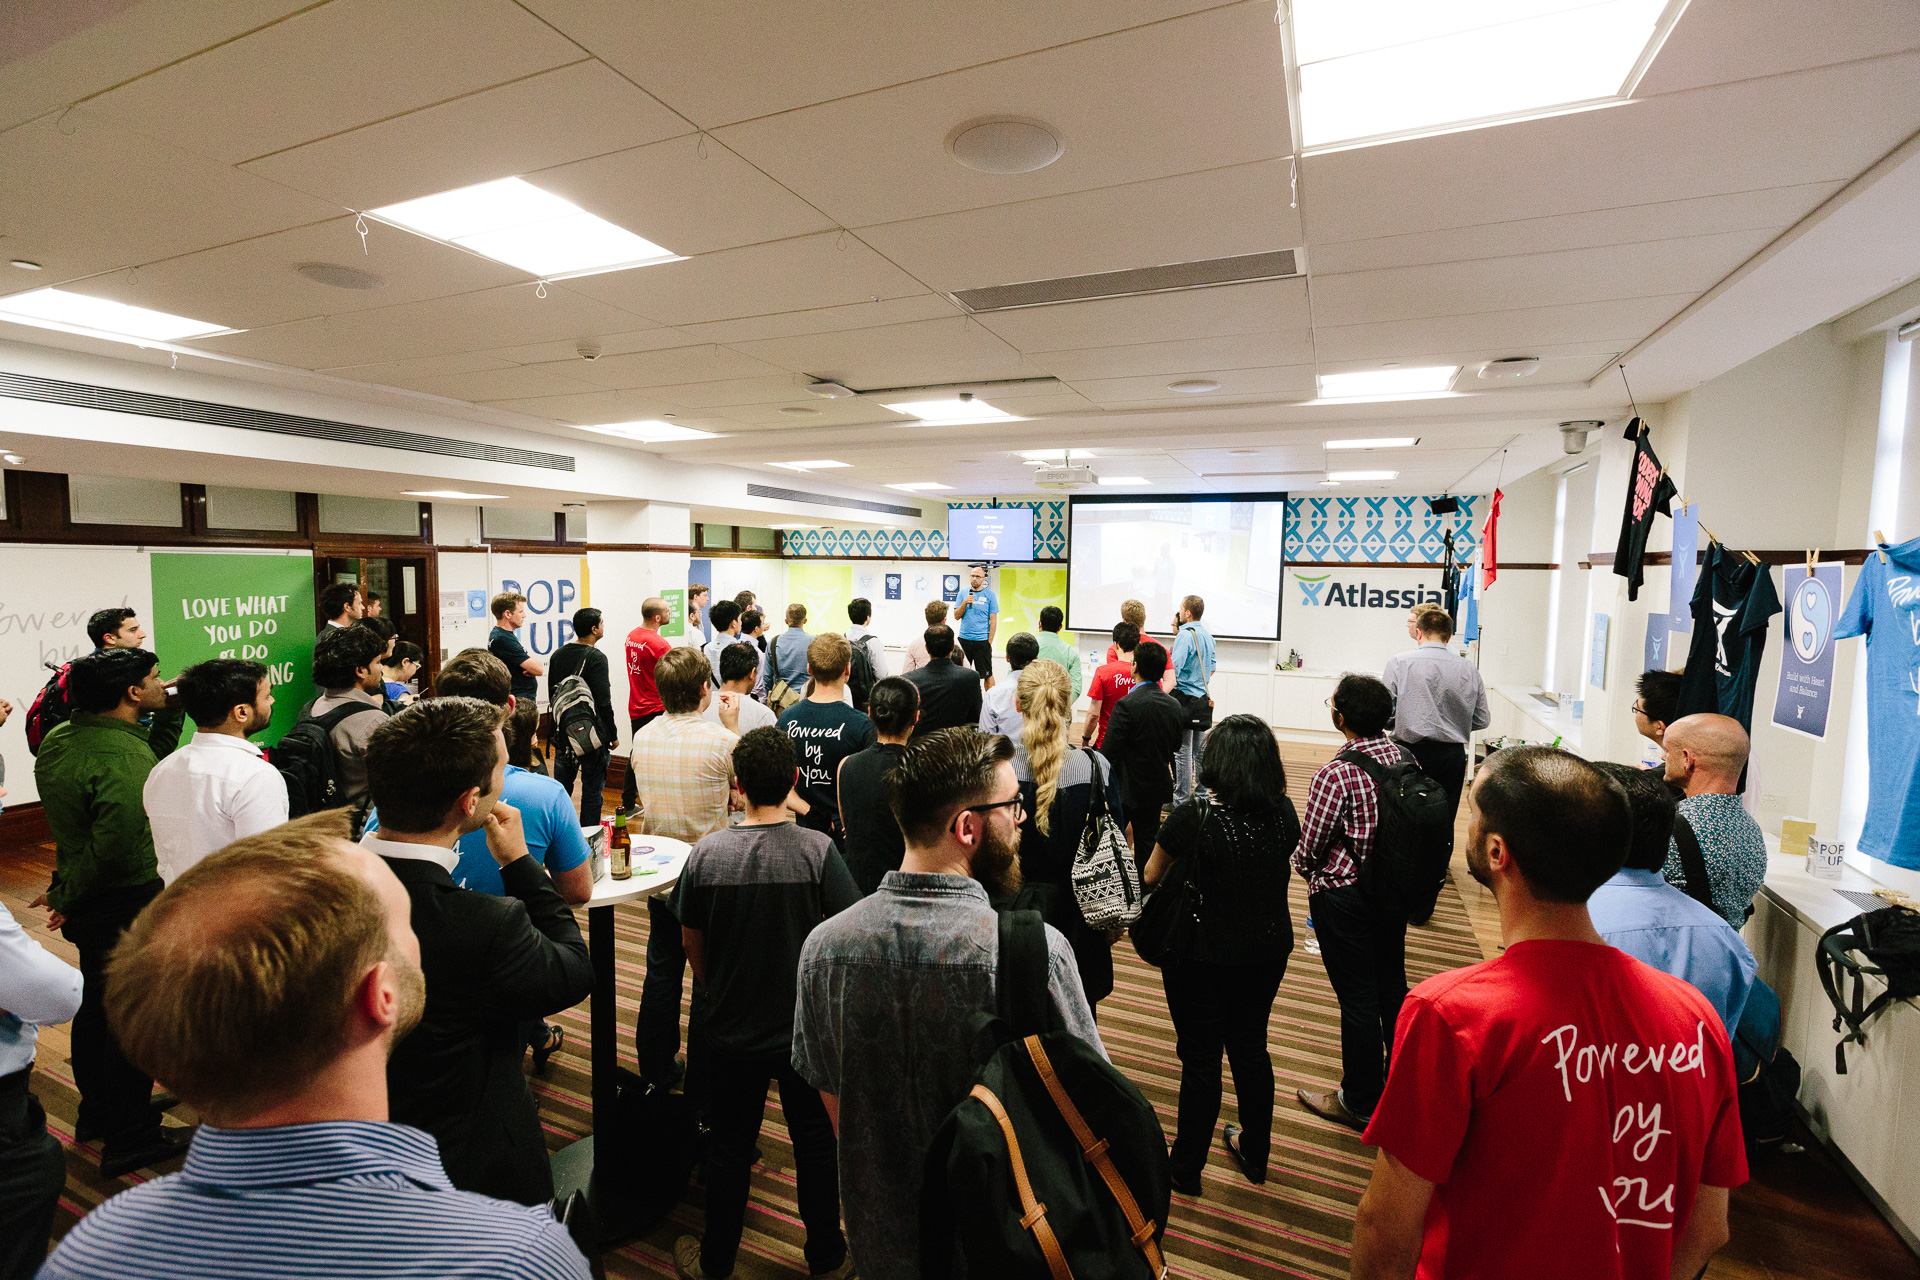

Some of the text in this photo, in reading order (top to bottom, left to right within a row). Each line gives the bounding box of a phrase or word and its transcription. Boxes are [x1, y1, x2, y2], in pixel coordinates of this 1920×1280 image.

[182, 595, 289, 620] LOVE WHAT
[204, 619, 278, 646] YOU DO
[530, 619, 575, 655] UP
[242, 644, 268, 659] DO
[1113, 673, 1136, 689] Powe
[1786, 671, 1825, 687] Build with Heart
[1789, 685, 1818, 698] and Balance
[787, 720, 846, 741] Powered
[805, 740, 824, 765] by
[1820, 843, 1844, 855] POP
[1827, 856, 1843, 866] UP
[1541, 1020, 1706, 1102] Powered
